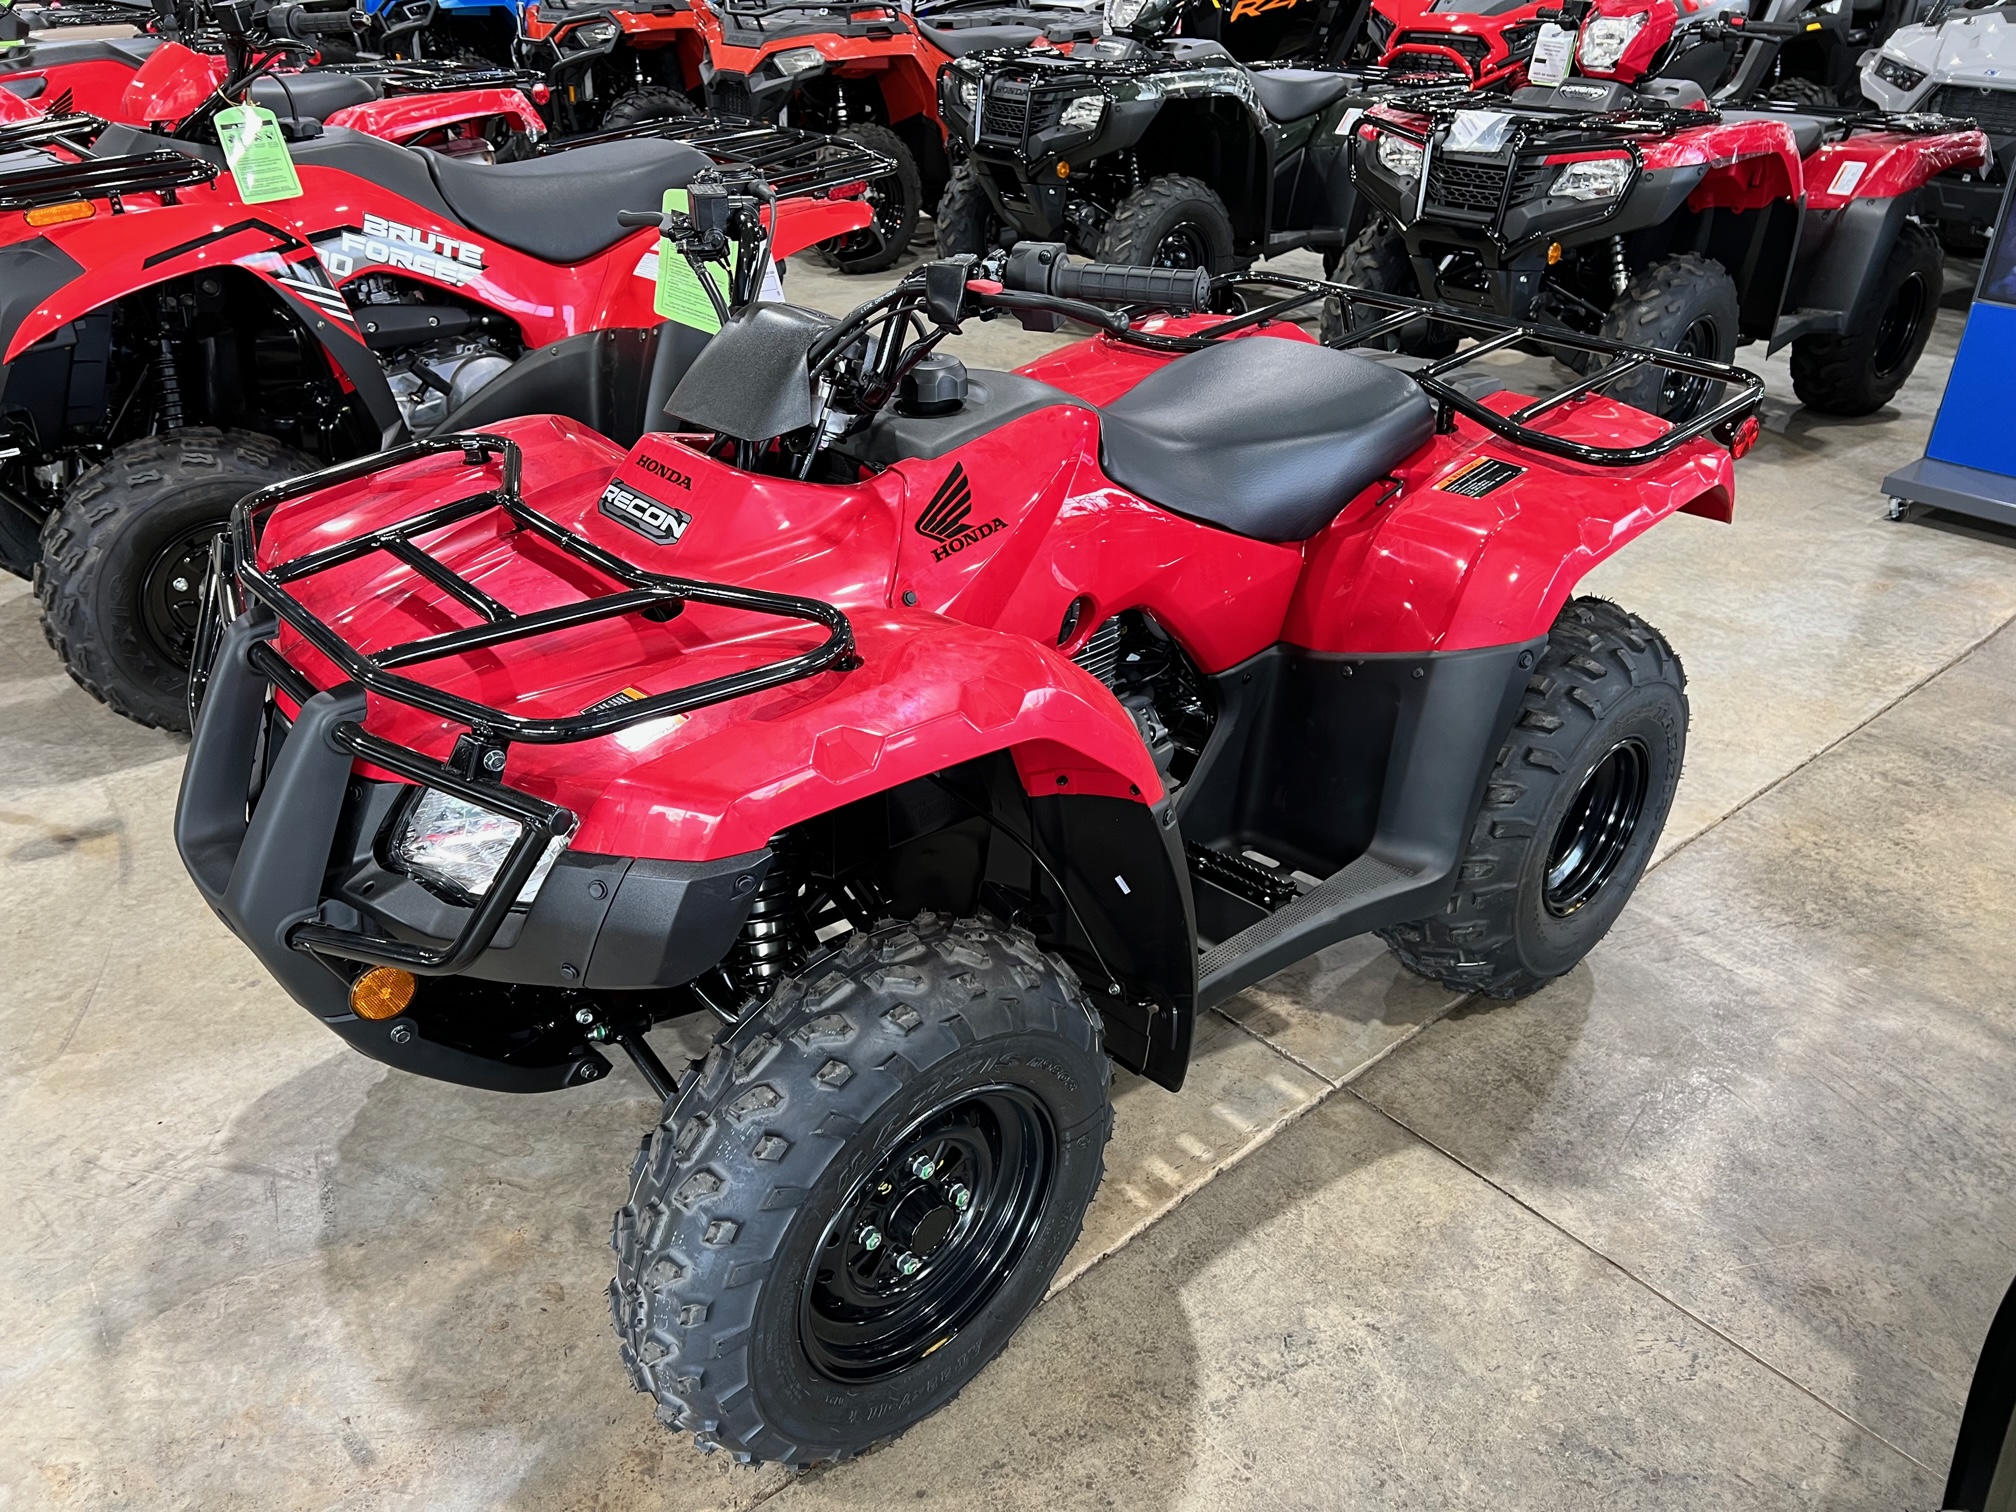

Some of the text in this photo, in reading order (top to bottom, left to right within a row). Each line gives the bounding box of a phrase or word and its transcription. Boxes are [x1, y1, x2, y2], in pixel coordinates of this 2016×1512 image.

[363, 212, 485, 269] BRUTE
[636, 454, 692, 491] HONDA
[602, 484, 688, 539] RECON
[931, 517, 1009, 563] HONDA
